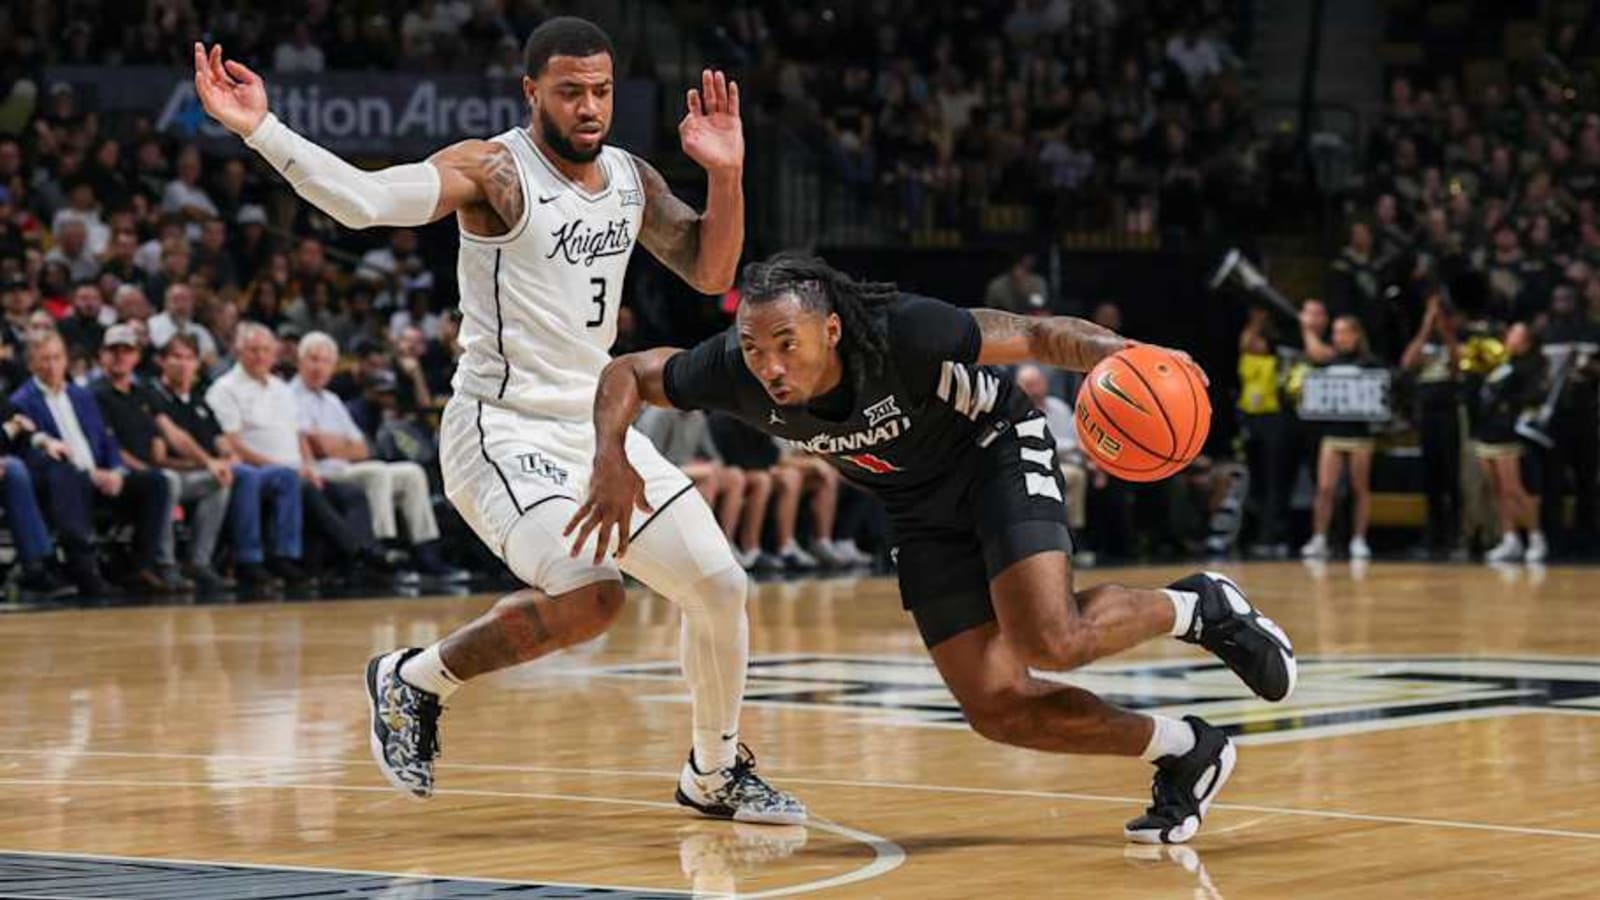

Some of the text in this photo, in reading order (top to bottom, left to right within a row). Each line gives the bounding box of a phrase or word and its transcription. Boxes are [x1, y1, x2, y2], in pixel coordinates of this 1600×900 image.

[547, 218, 632, 267] Knights
[586, 277, 606, 327] 3
[515, 452, 568, 486] UCF
